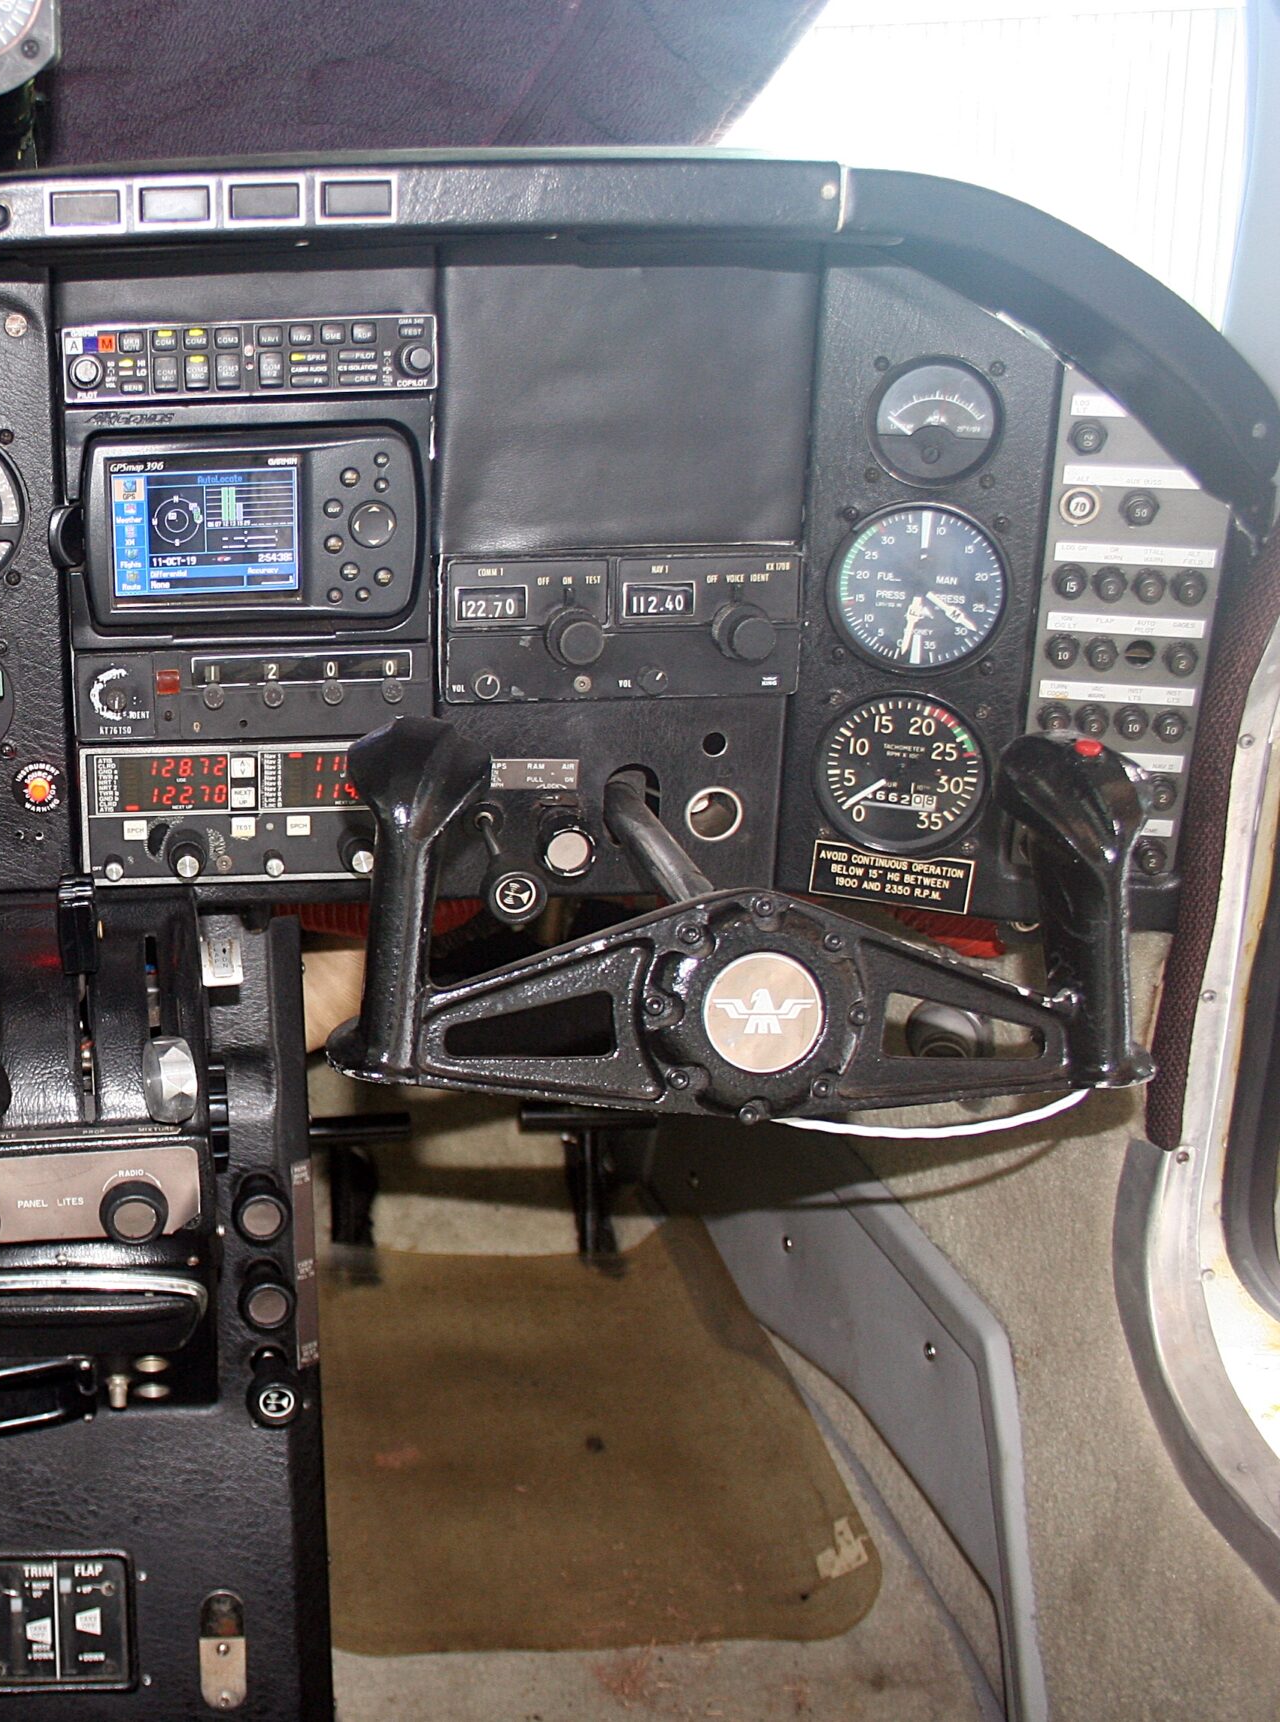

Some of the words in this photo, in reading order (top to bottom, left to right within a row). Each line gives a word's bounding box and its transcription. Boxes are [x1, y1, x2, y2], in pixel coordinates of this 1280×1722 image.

[397, 379, 427, 387] COPILOT
[110, 464, 144, 473] GPSmap
[146, 462, 164, 471] 396
[906, 525, 918, 534] 35
[881, 536, 894, 544] 30
[865, 551, 878, 559] 25
[121, 561, 141, 569] Flights
[153, 556, 197, 566] 11-OCT-19
[478, 568, 497, 576] COMM
[856, 571, 869, 579] 20
[975, 573, 988, 581] 20
[538, 577, 549, 586] OFF
[585, 575, 600, 585] TEST
[707, 575, 718, 583] OFF
[726, 574, 744, 583] VOICE
[750, 574, 769, 582] IDENT
[936, 576, 957, 584] MAN
[122, 583, 141, 591] Route
[151, 581, 170, 589] None
[876, 591, 905, 599] PRESS
[462, 598, 515, 618] 122.70
[633, 594, 684, 613] 112.40
[874, 716, 893, 733] 15
[909, 719, 935, 736] 20
[1128, 724, 1139, 732] 10
[850, 738, 869, 755] 10
[884, 744, 925, 752] TACHOMETER
[931, 743, 957, 761] 25
[15, 763, 60, 781] INSTRUMENT
[937, 776, 963, 794] 30
[25, 799, 60, 812] WARNING
[917, 812, 942, 830] 35
[820, 850, 848, 862] AVOID
[852, 854, 908, 870] CONTINUOUS
[912, 863, 964, 878] OPERATION
[831, 864, 864, 876] BELOW
[887, 873, 900, 882] HG
[904, 874, 950, 888] BETWEEN
[835, 877, 858, 887] 1900
[862, 880, 880, 891] AND
[885, 885, 910, 895] 2350
[914, 888, 941, 900] R.P.M.
[18, 1200, 48, 1208] PANEL
[57, 1198, 84, 1206] LITES
[24, 1566, 52, 1578] TRIM
[74, 1564, 103, 1576] FLAP
